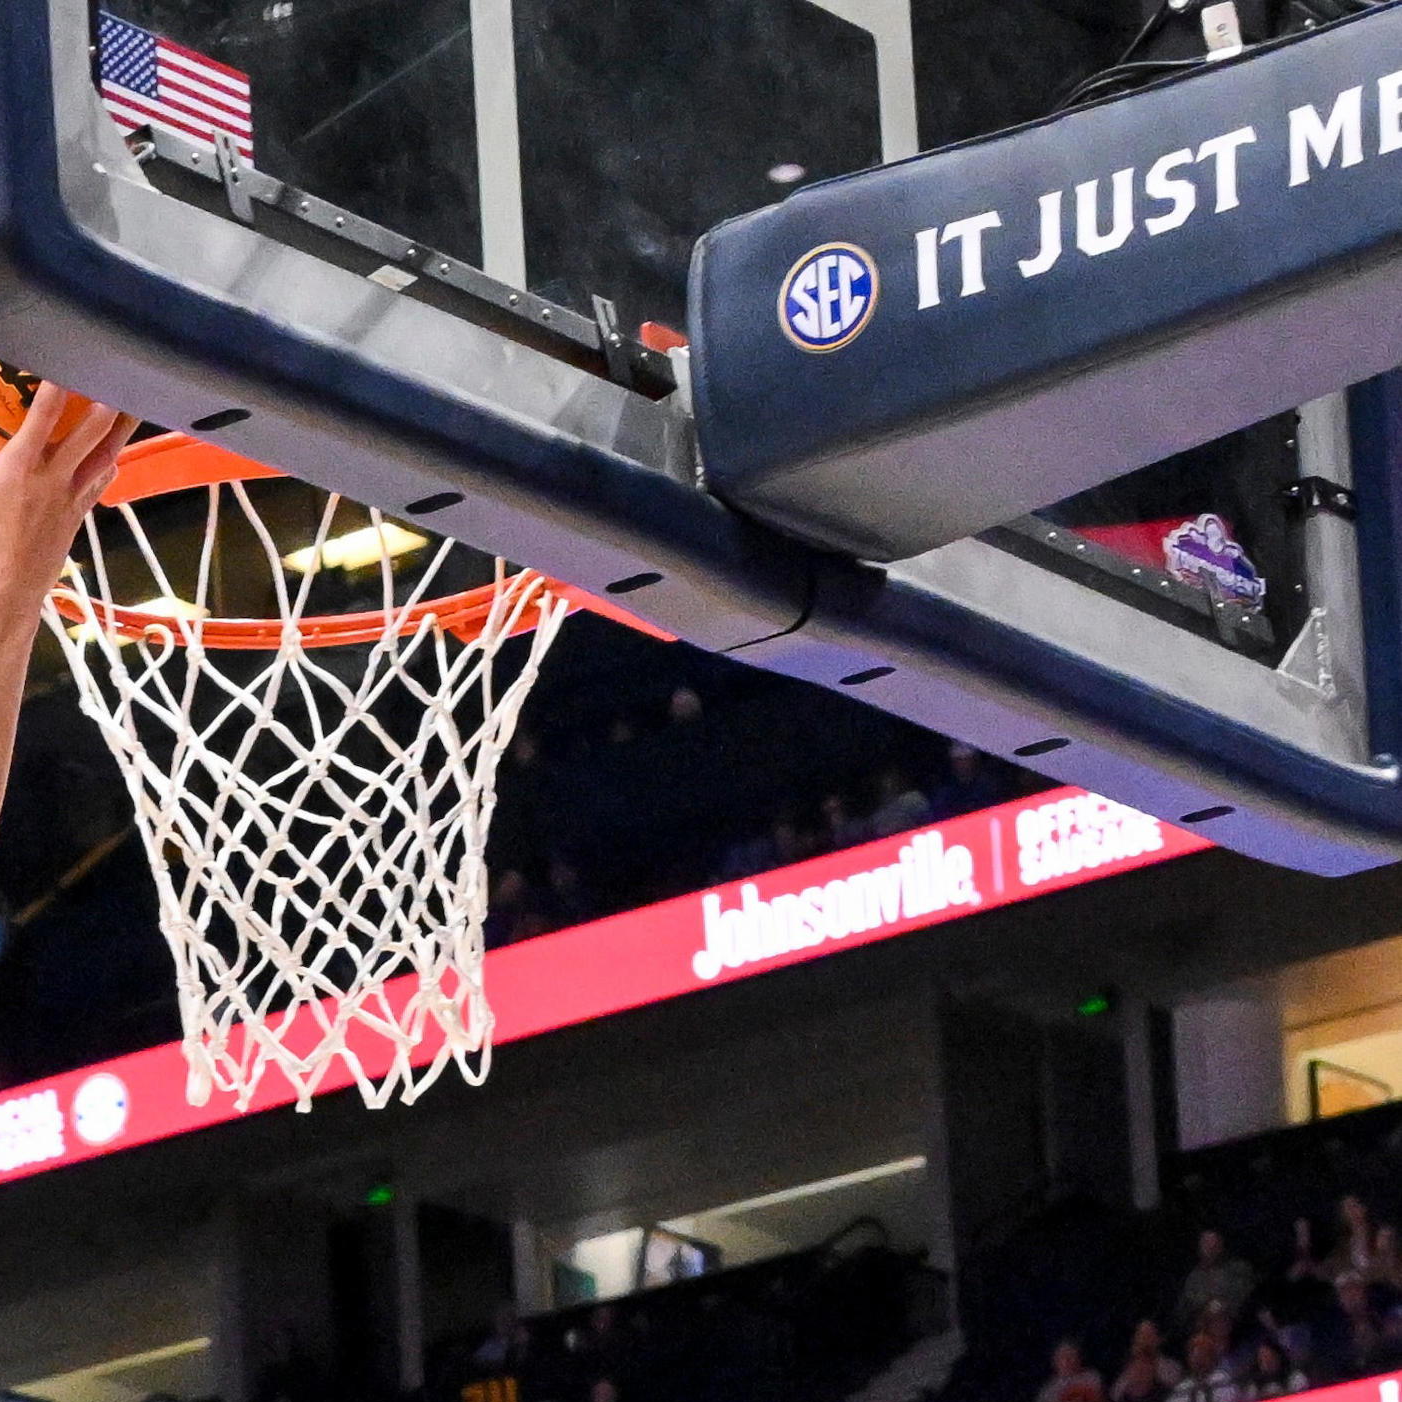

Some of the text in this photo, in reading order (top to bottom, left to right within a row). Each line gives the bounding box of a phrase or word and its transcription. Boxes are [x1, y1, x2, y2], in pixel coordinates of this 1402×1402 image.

[786, 248, 868, 339] SEC
[913, 210, 1002, 311] IT
[1017, 126, 1258, 280] JUST
[693, 830, 978, 980] Johnsonville
